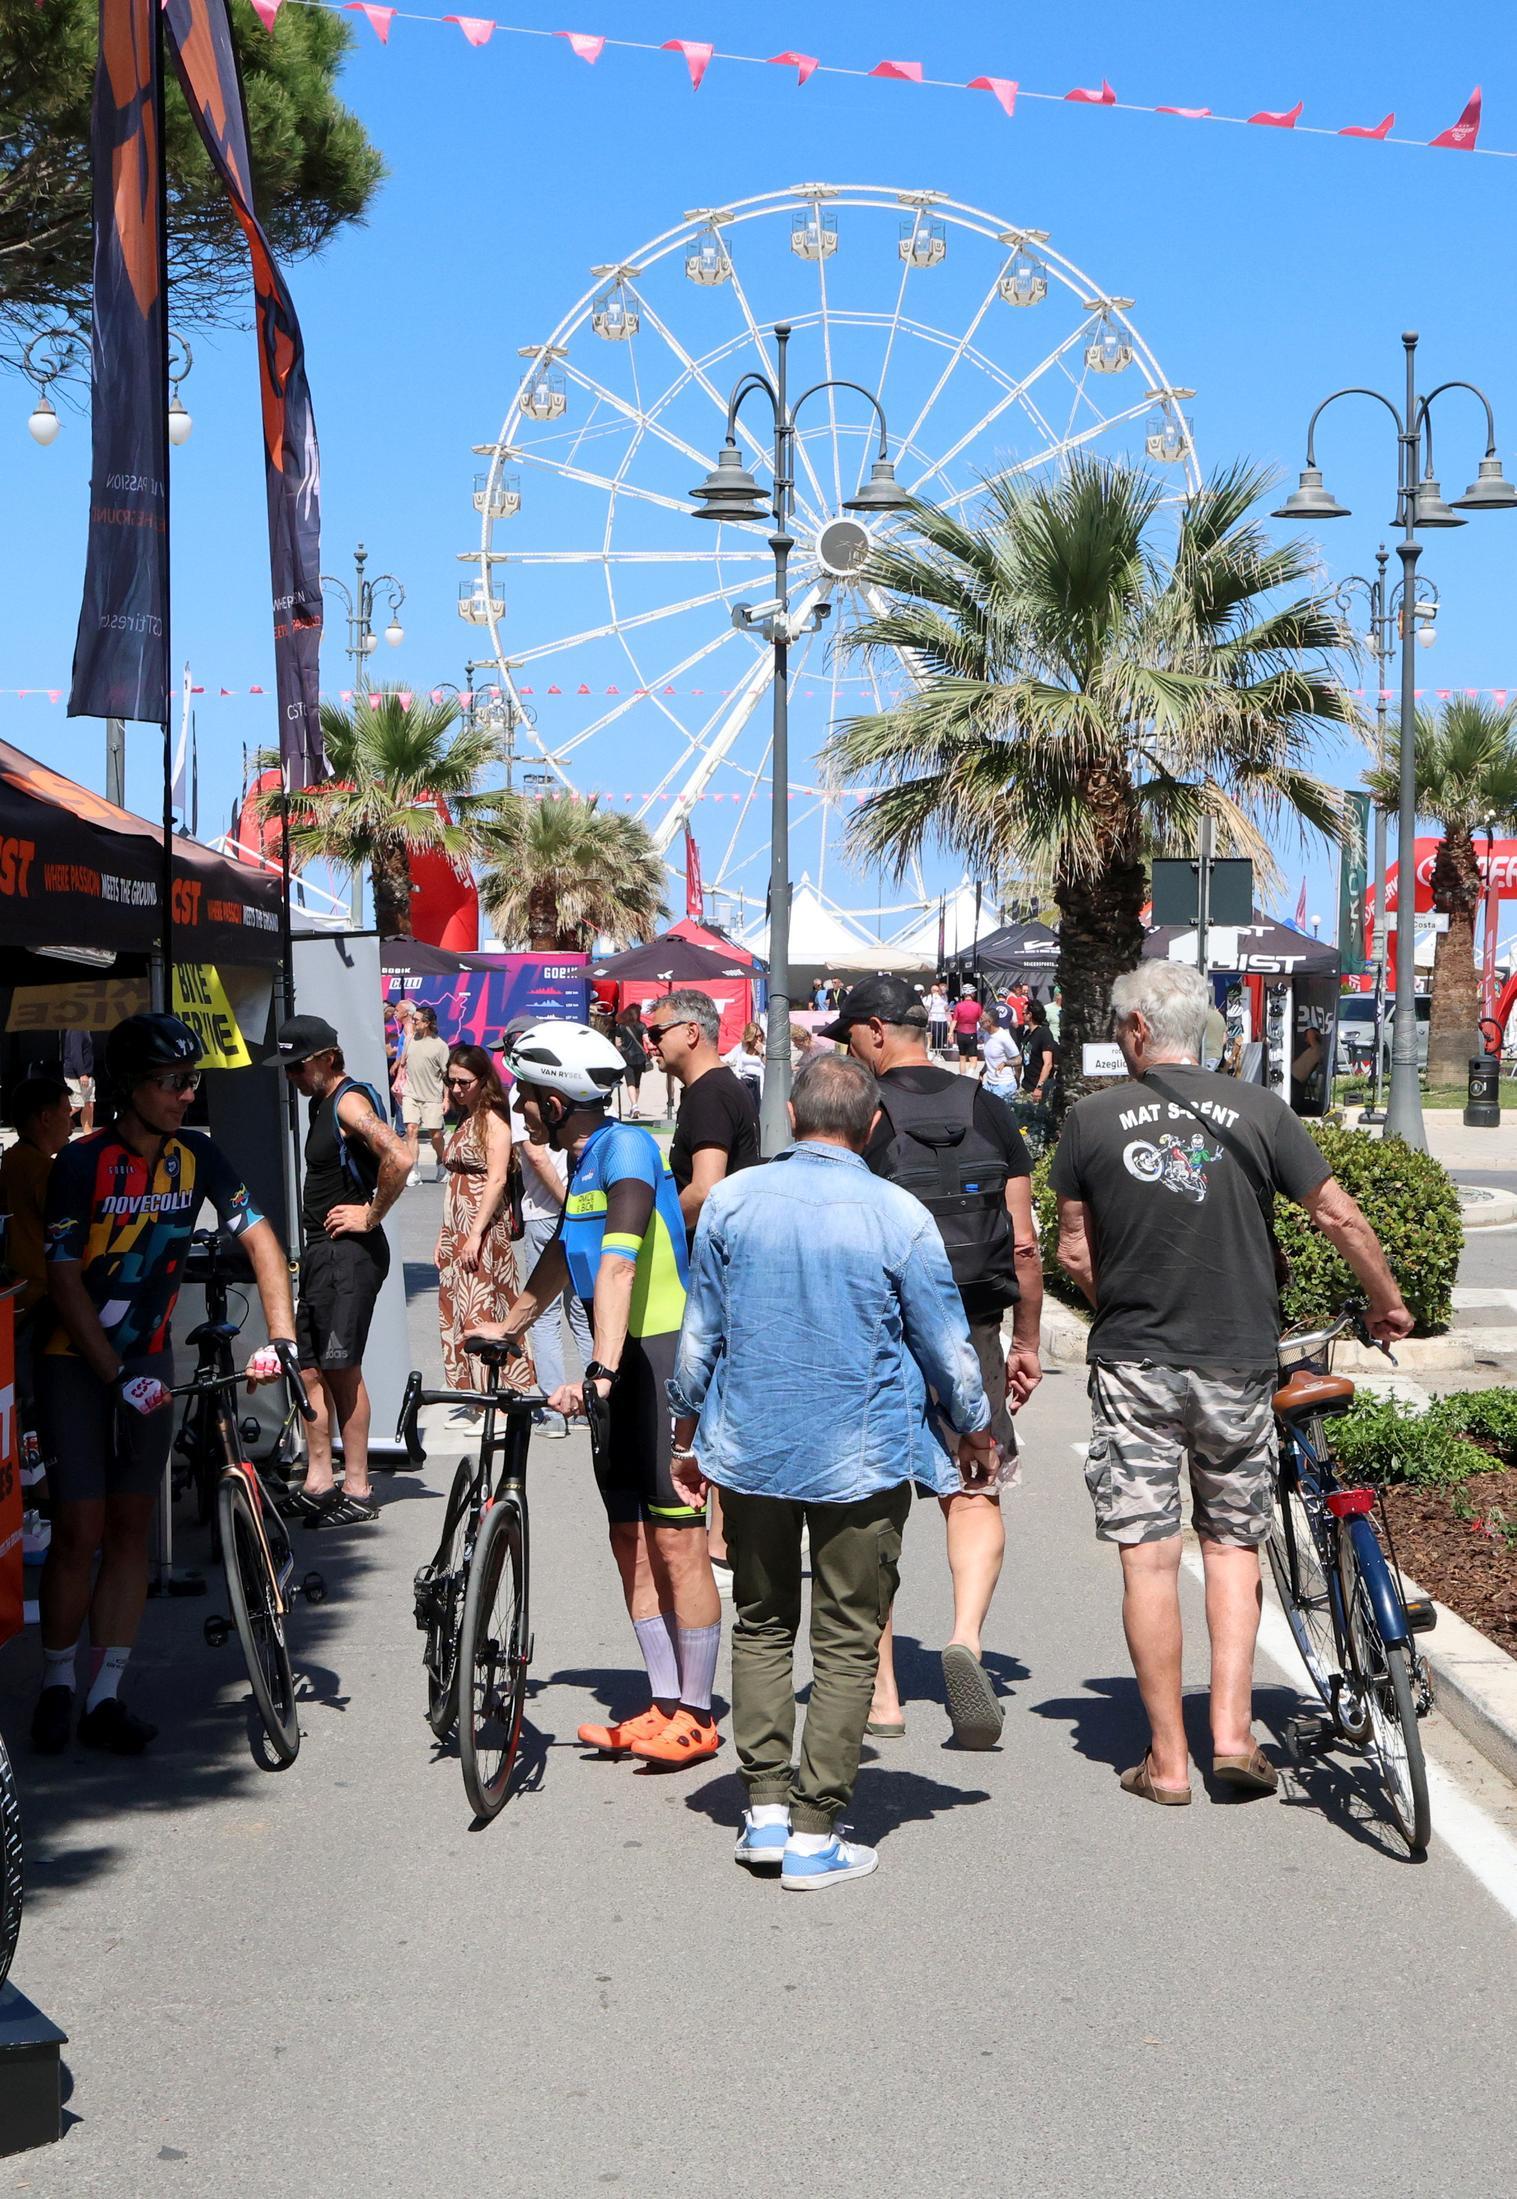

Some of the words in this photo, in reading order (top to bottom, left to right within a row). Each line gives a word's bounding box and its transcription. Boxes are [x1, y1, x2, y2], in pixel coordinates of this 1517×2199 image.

[0, 836, 36, 897] ST
[101, 872, 119, 903] MEETS
[120, 878, 131, 904] THE
[131, 880, 158, 906] GROUND
[172, 878, 202, 926] CST
[541, 1068, 556, 1077] VAN
[559, 1071, 582, 1080] RYSEL
[1119, 1103, 1161, 1130] MAT
